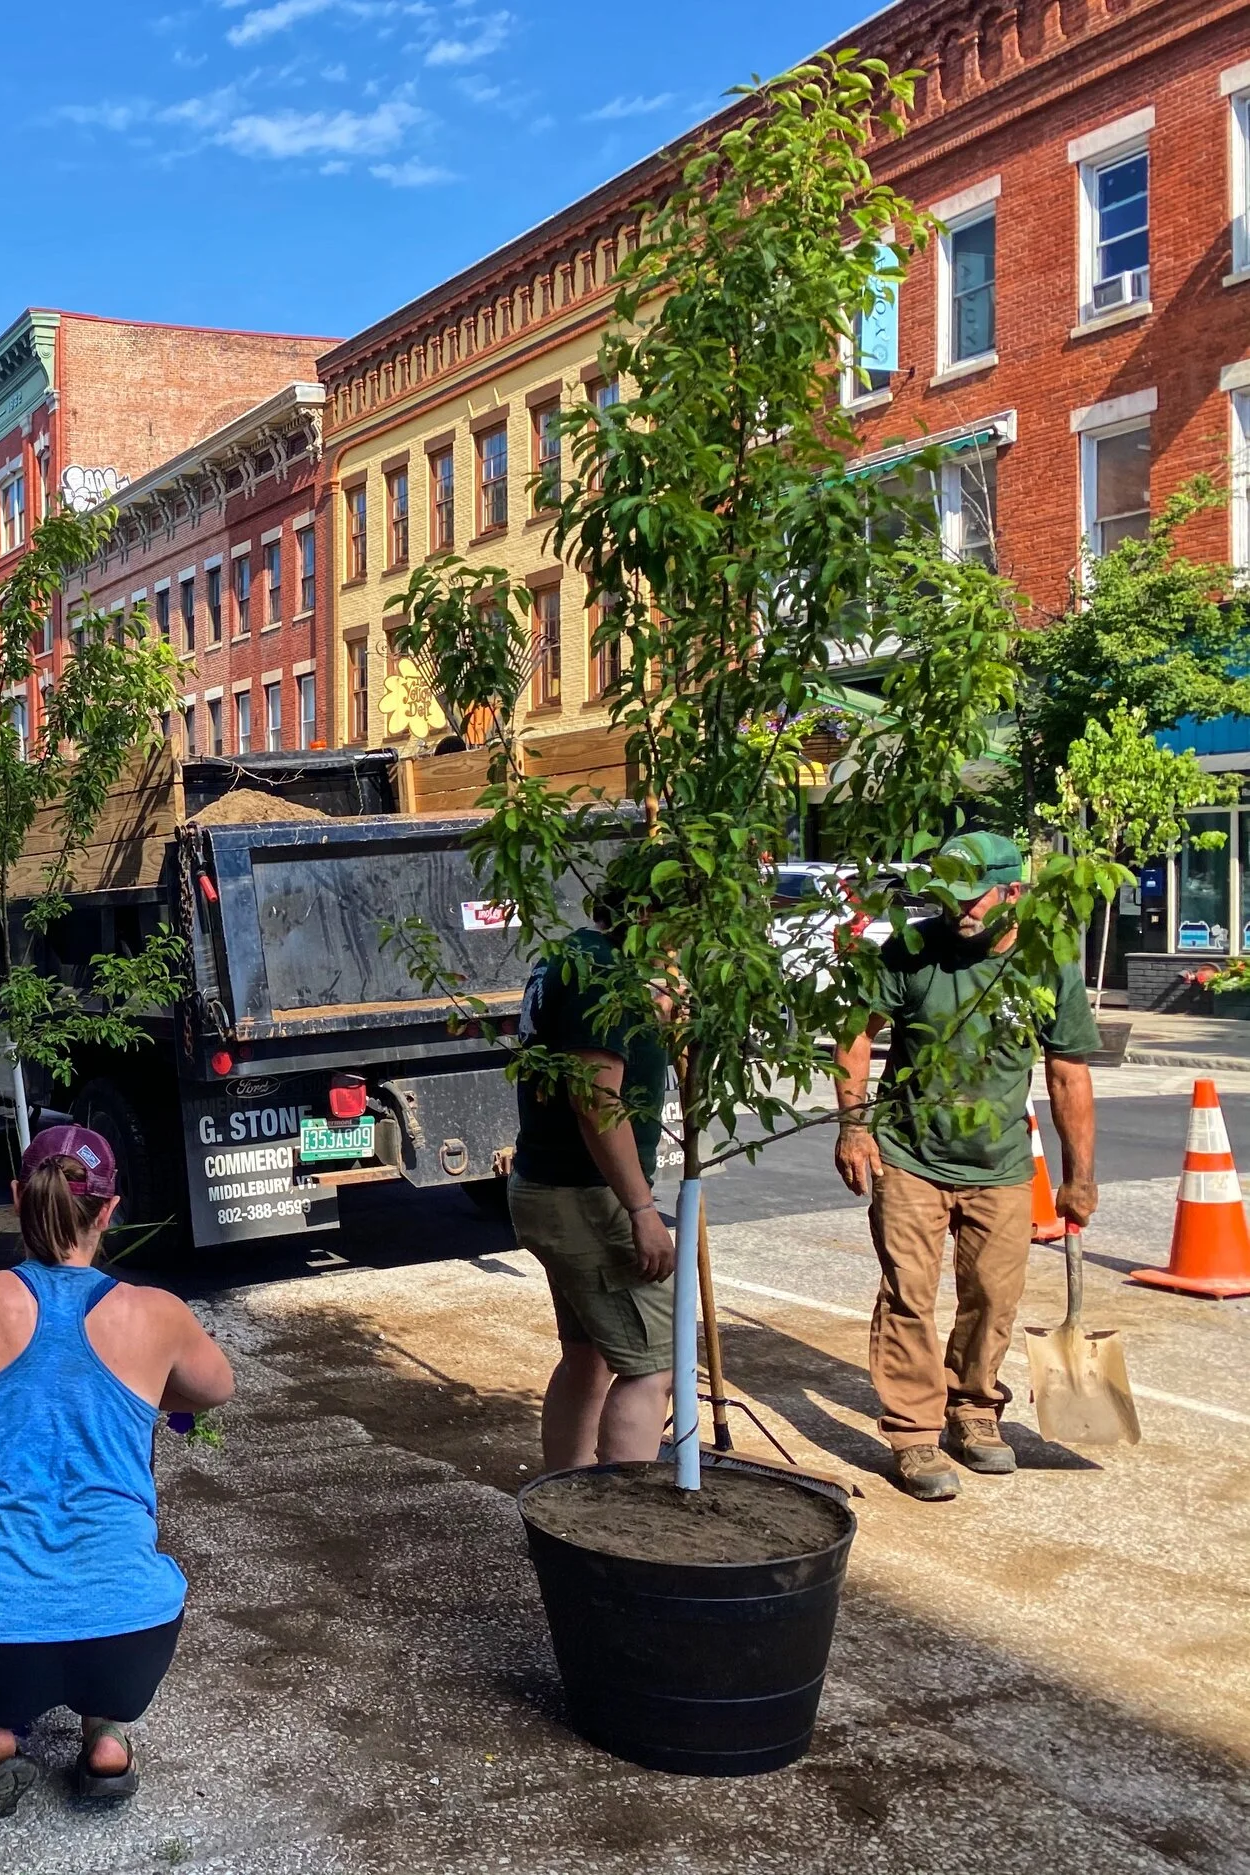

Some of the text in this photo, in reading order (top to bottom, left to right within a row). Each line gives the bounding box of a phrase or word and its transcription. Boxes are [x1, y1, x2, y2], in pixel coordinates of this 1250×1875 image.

[404, 701, 432, 721] Deli
[236, 1078, 269, 1094] Ford
[199, 1115, 223, 1145] G.
[309, 1127, 371, 1150] 353A909
[208, 1176, 295, 1202] MIDDLEBURY,
[217, 1198, 312, 1225] 802-388-9599
